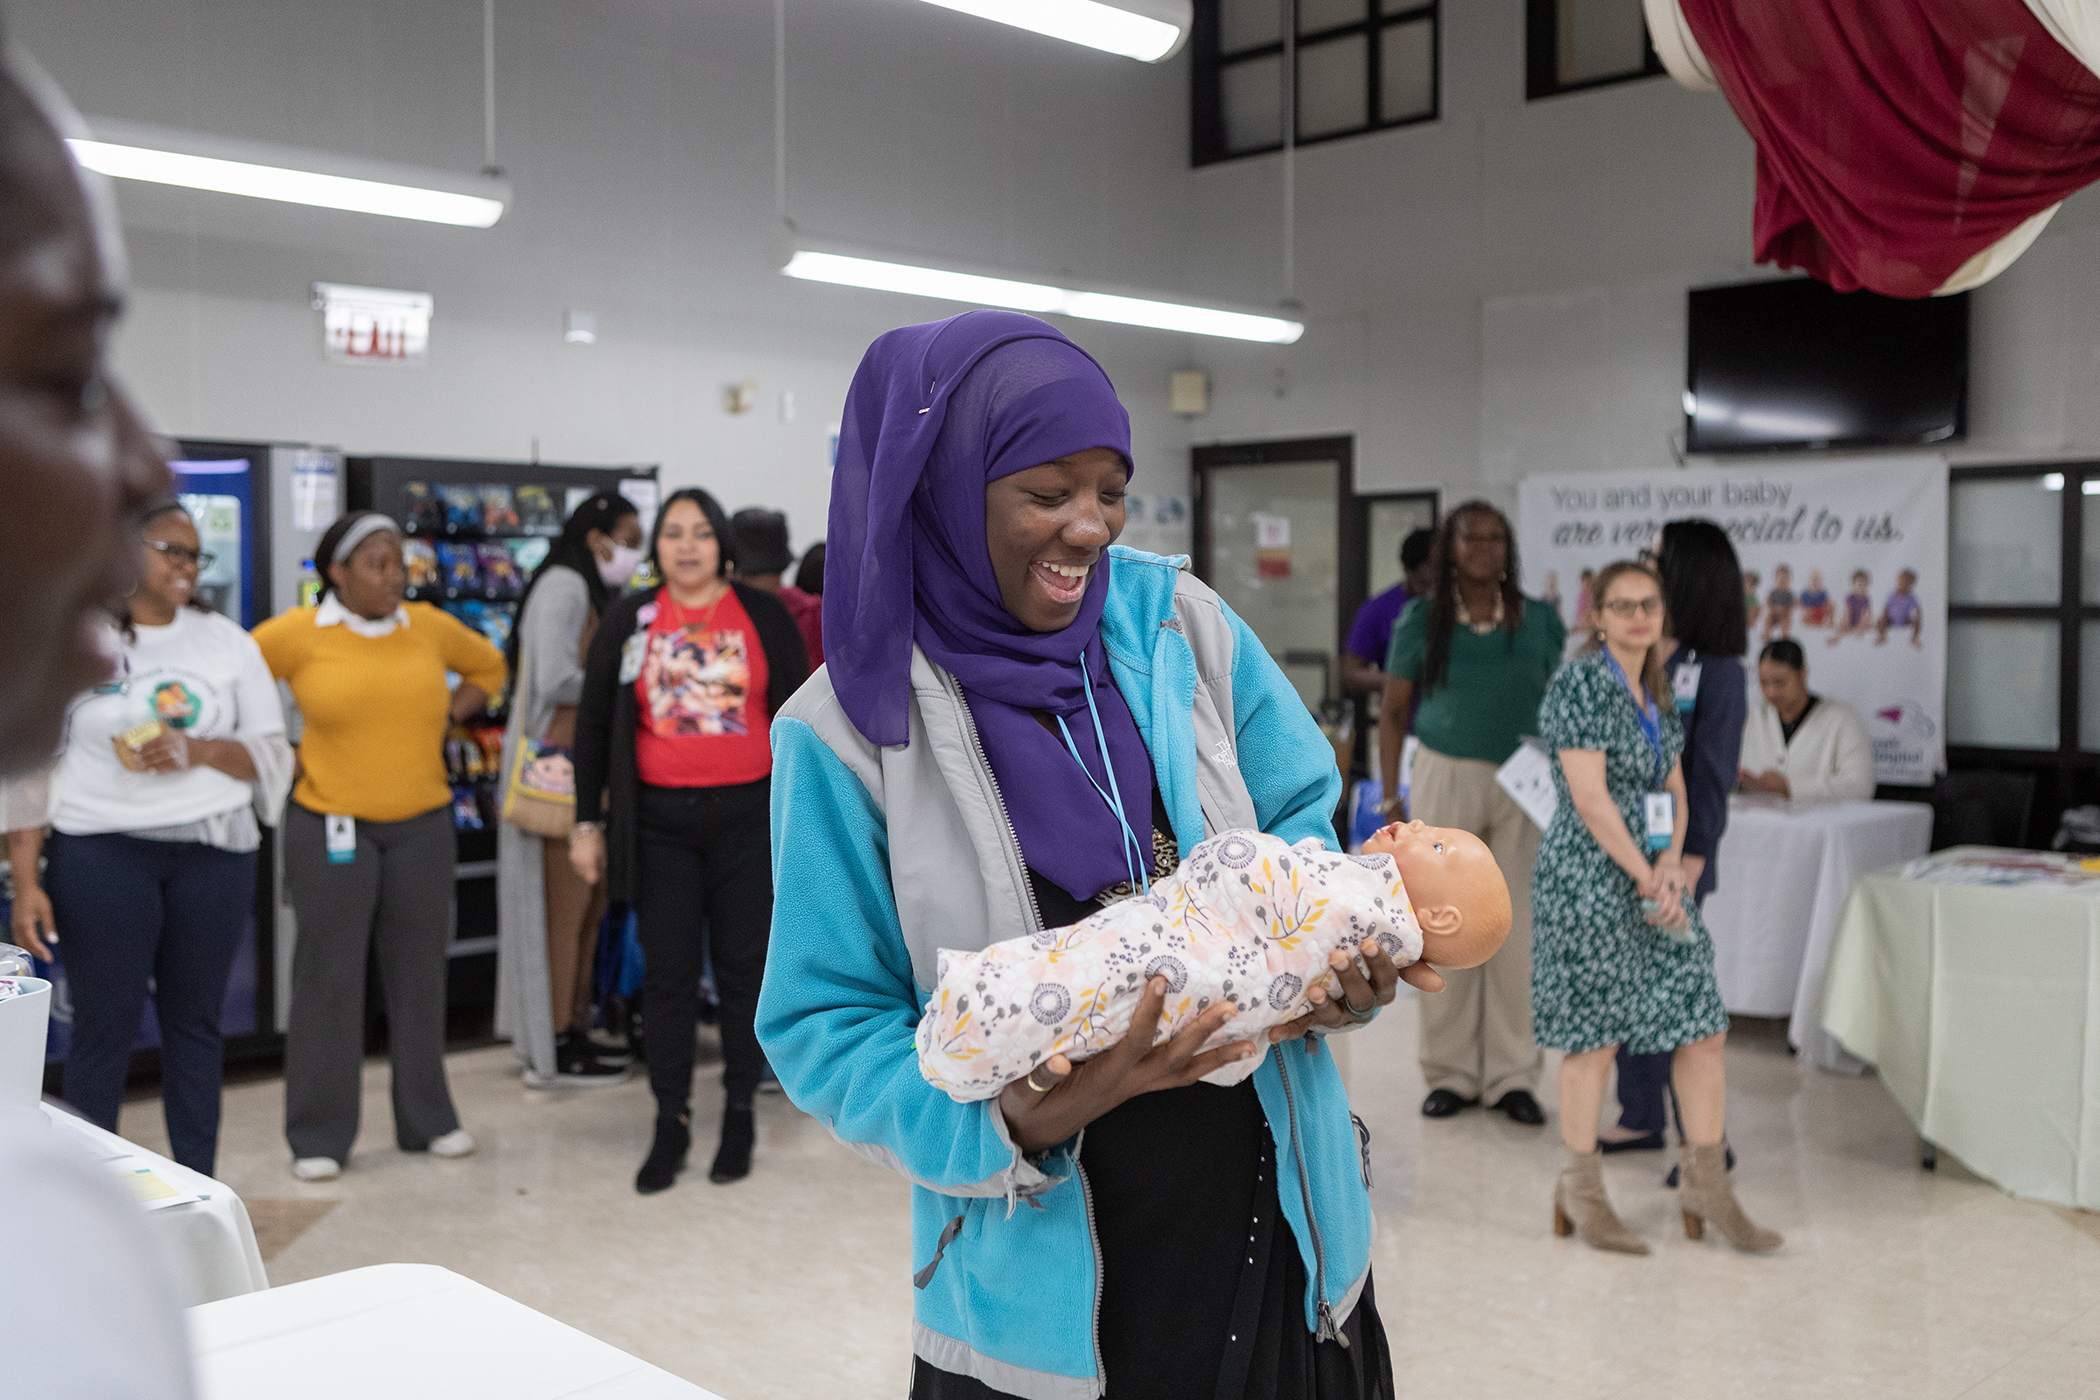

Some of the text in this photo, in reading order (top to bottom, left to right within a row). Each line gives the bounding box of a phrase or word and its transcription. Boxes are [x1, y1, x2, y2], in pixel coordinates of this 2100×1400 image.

[1551, 478, 1793, 516] You and your baby
[1551, 503, 1904, 548] are ver ecial to us.
[1214, 735, 1231, 751] TH
